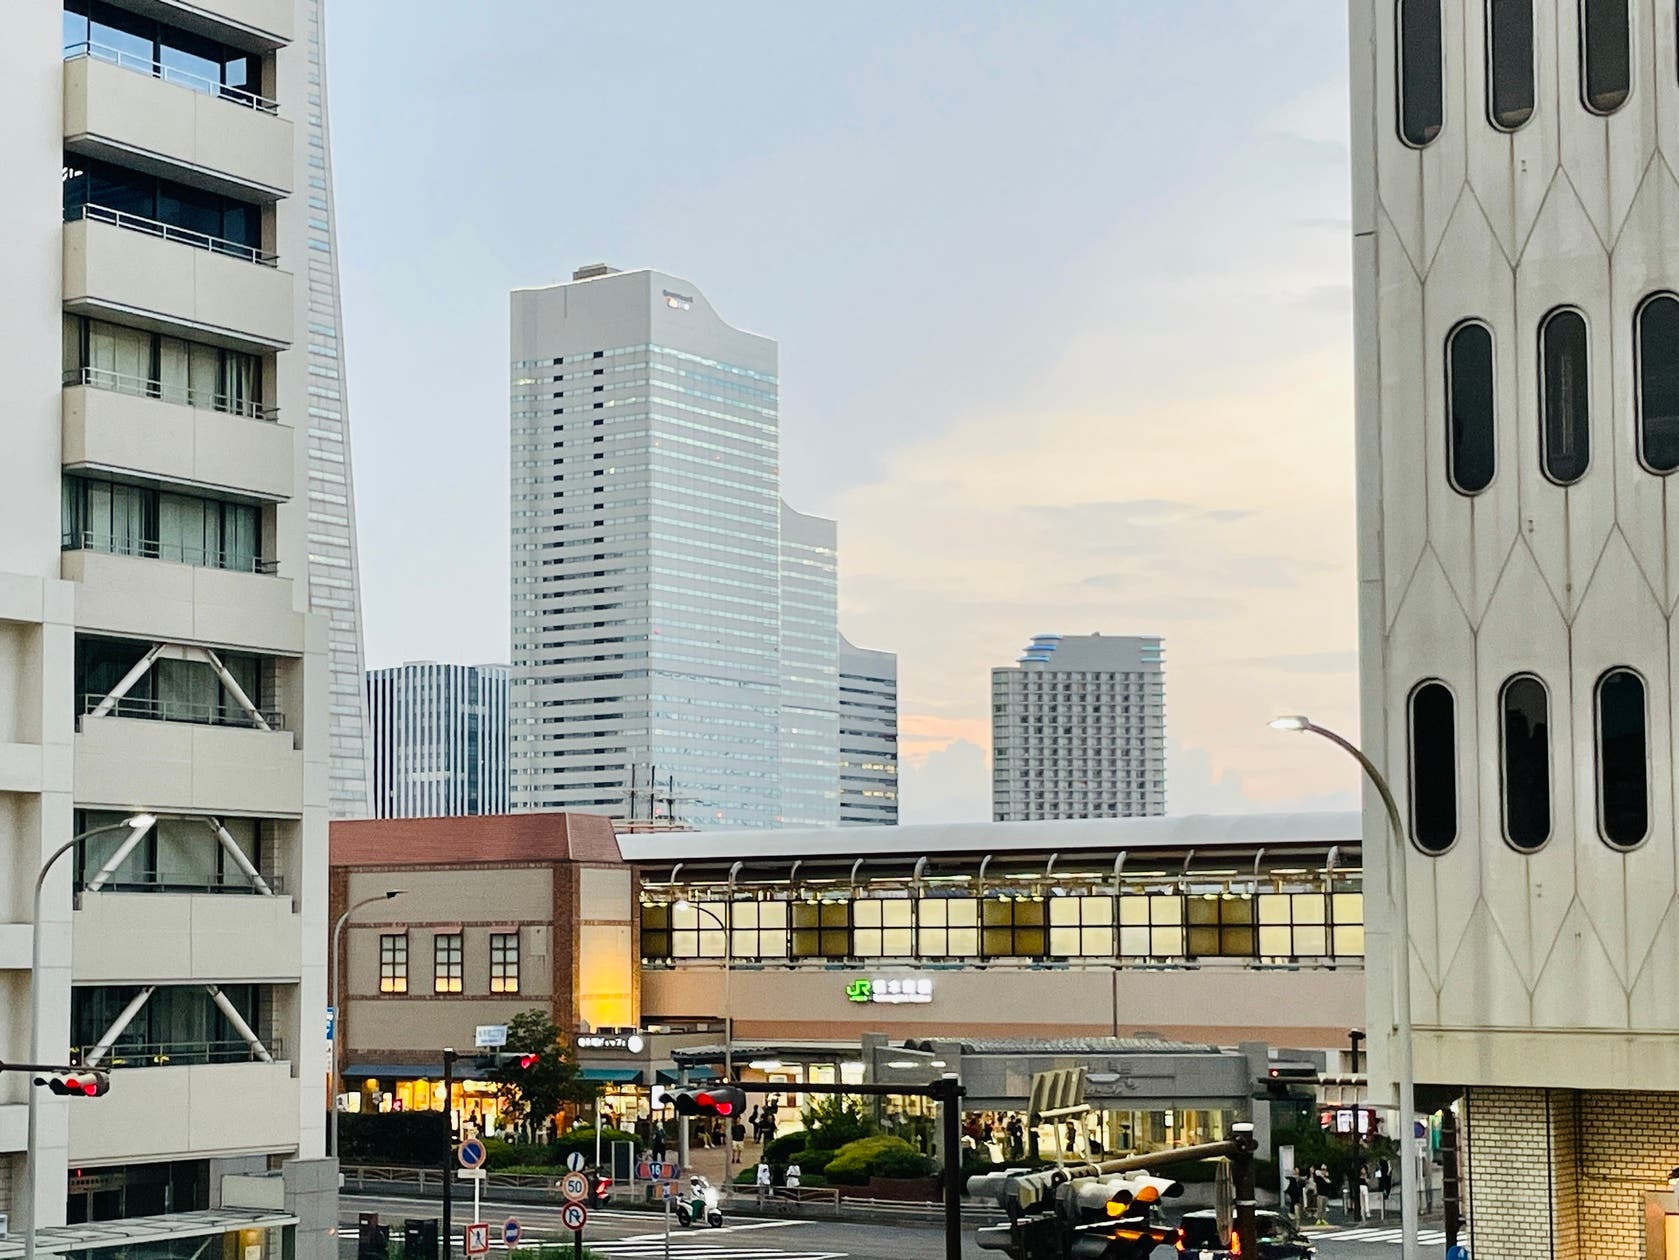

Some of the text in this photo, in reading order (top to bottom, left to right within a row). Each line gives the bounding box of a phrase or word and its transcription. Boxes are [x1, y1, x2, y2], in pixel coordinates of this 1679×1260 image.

[846, 980, 871, 996] JR
[651, 1164, 661, 1175] 16
[568, 1180, 582, 1193] 50
